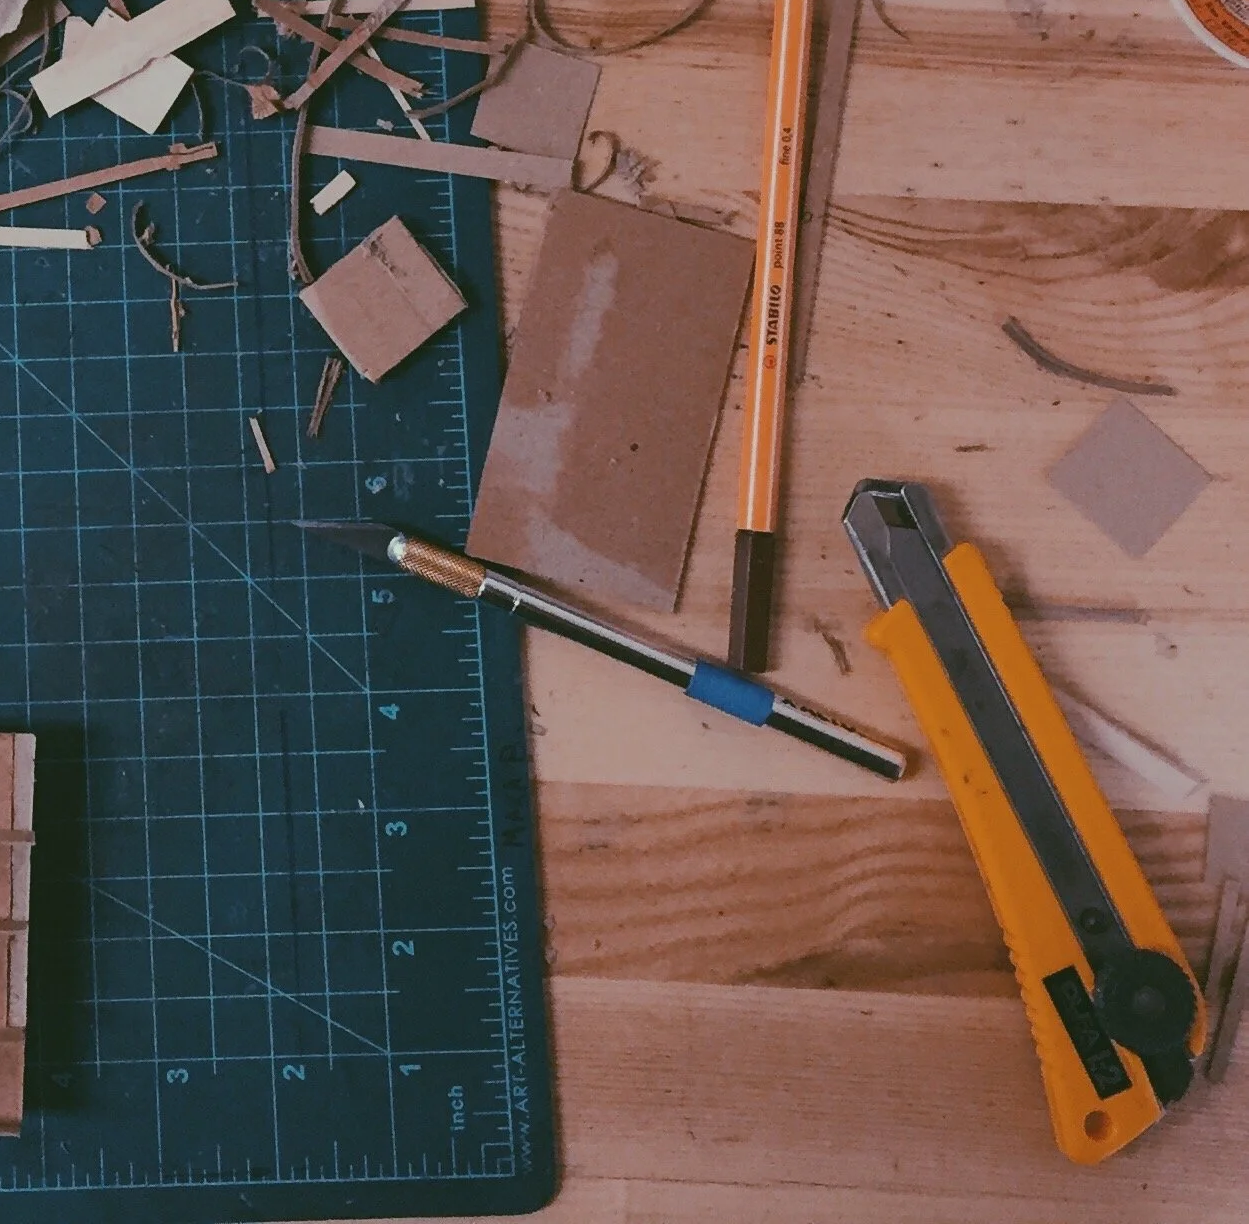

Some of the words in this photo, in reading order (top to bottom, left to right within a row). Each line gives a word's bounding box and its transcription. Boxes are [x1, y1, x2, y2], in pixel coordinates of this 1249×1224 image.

[778, 144, 791, 166] fine
[775, 221, 785, 238] 88
[774, 238, 784, 270] point
[765, 284, 782, 346] STABILO
[364, 474, 388, 495] 6
[372, 587, 394, 605] 5
[379, 703, 401, 722] 4
[385, 821, 408, 837] 3
[393, 939, 416, 957] 2
[503, 864, 533, 1175] www.ART-ALTERNATIVES.com
[166, 1067, 189, 1084] 3
[283, 1065, 306, 1081] 2
[399, 1064, 421, 1076] 1
[449, 1084, 466, 1133] inch
